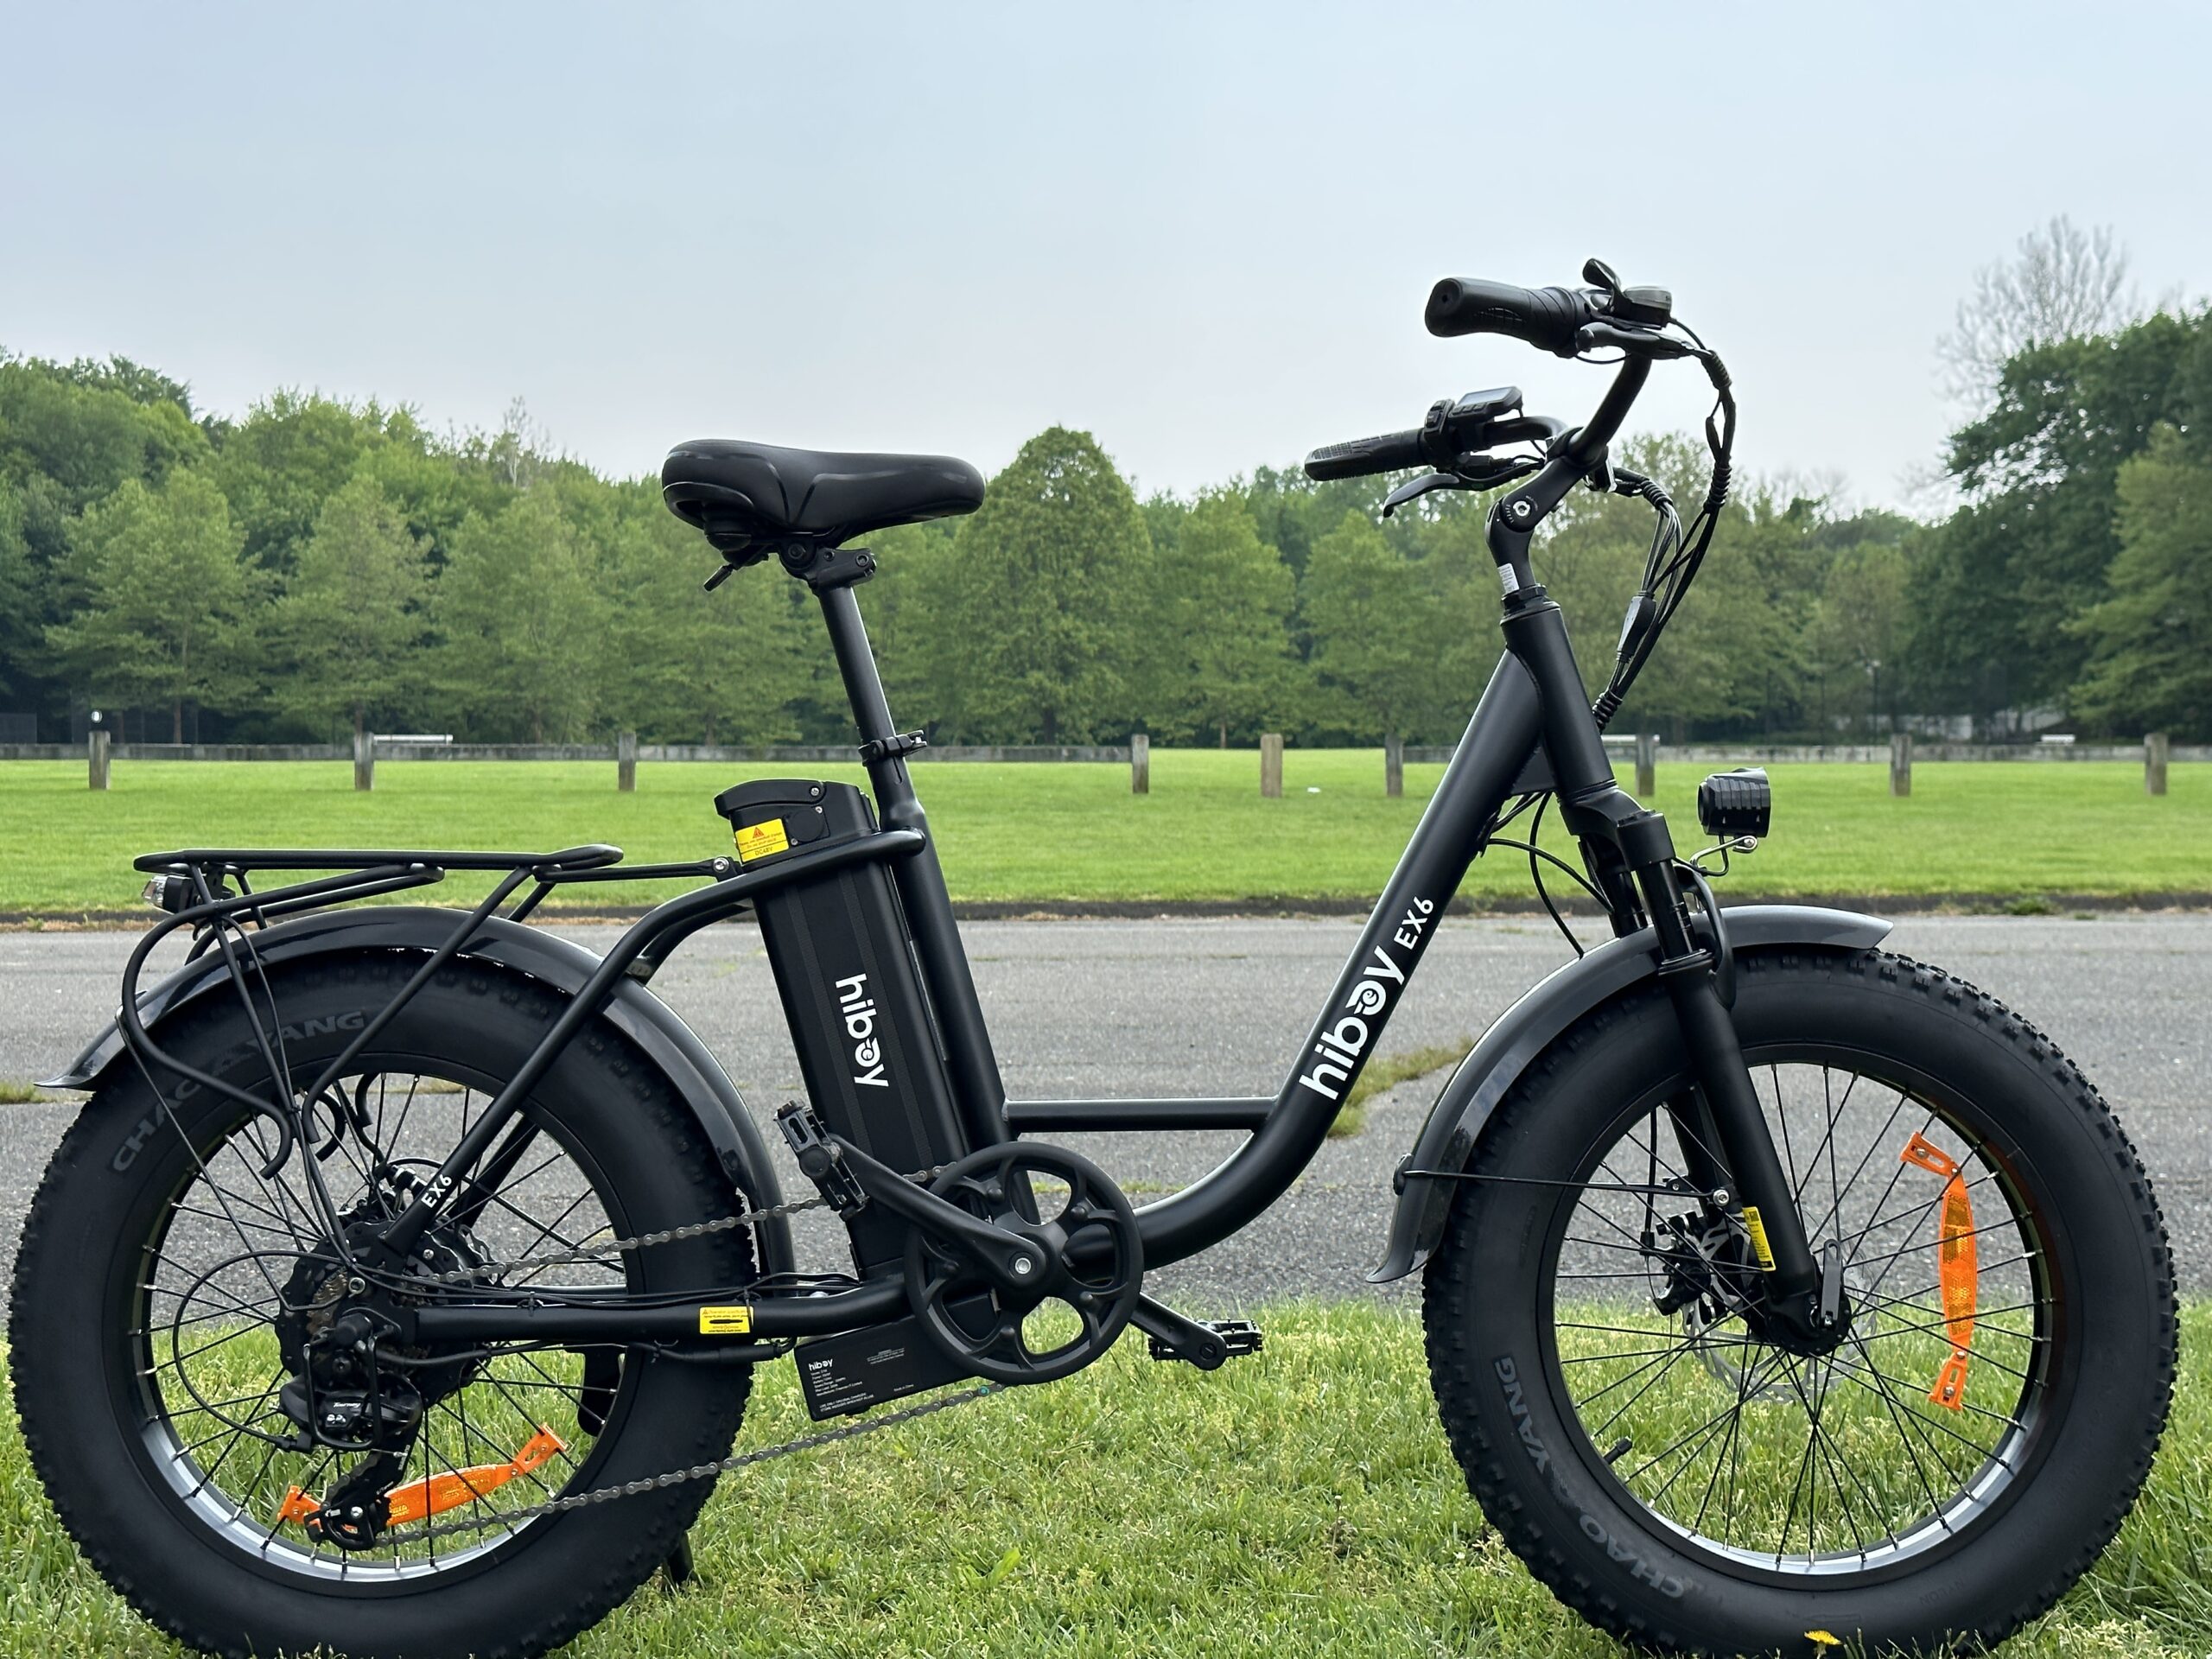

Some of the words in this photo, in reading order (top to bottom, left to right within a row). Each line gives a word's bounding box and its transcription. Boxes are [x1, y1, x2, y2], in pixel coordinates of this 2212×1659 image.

[835, 973, 889, 1087] hiboy
[1299, 944, 1405, 1101] hiboy
[1393, 896, 1434, 950] EX6
[421, 1173, 453, 1209] EX6
[808, 1358, 834, 1372] hiboy
[1493, 1356, 1550, 1474] YANG
[1579, 1514, 1685, 1599] CHAO
